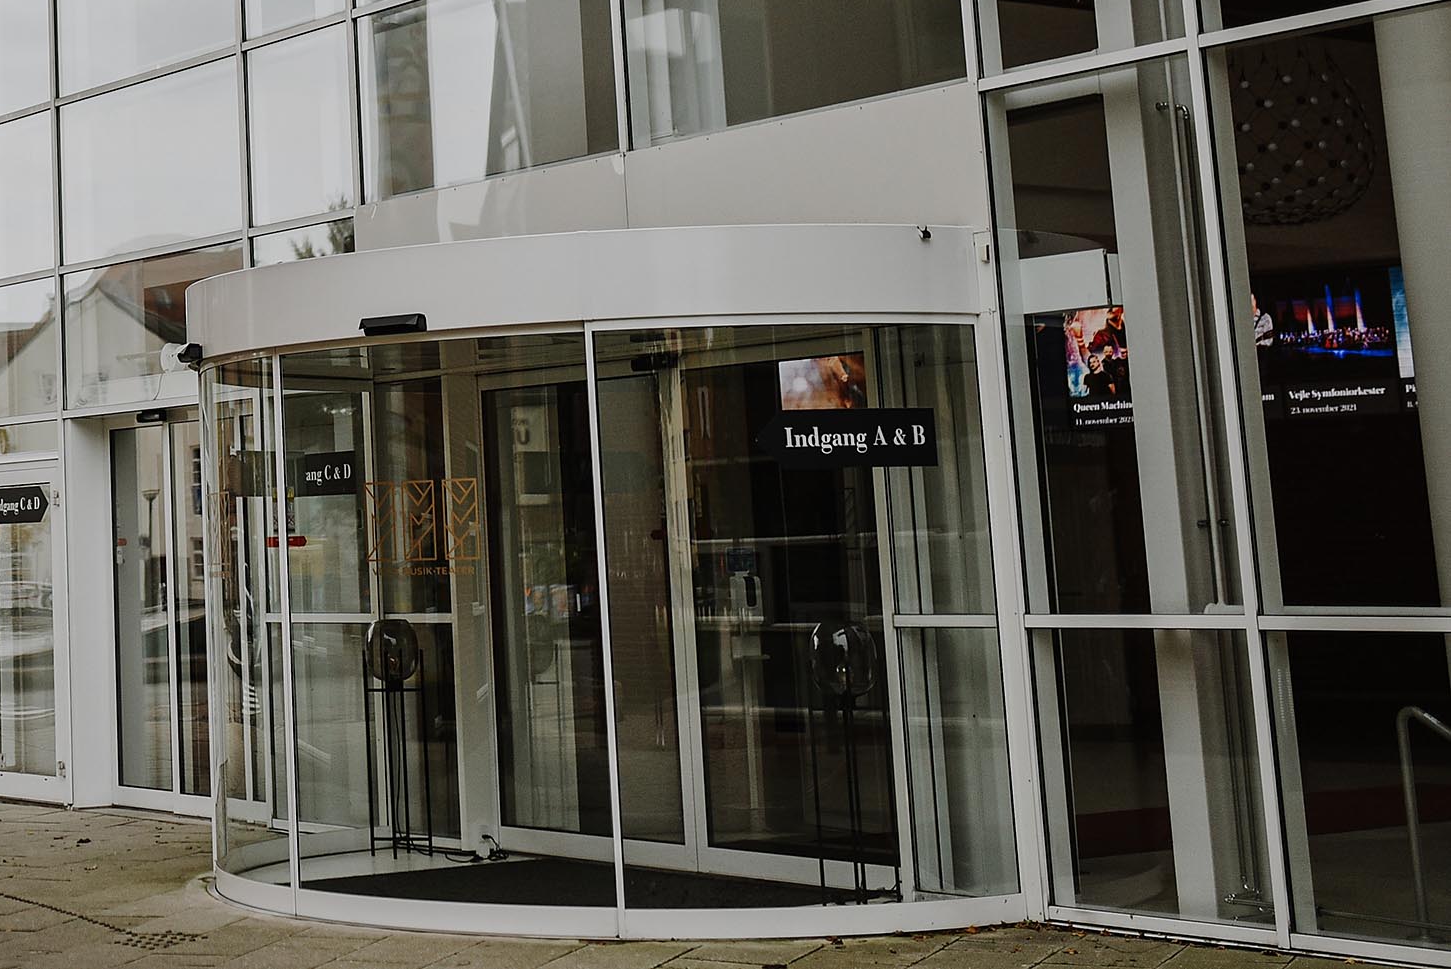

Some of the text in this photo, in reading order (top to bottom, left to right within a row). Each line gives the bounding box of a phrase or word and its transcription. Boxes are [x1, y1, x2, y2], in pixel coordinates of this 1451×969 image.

[1288, 386, 1386, 401] Vejle Symfoniorkester
[1073, 403, 1100, 413] Queen
[1302, 404, 1339, 414] november
[1340, 404, 1357, 412] 2021
[1084, 416, 1118, 426] november
[784, 424, 926, 455] Indgang A & B
[324, 464, 332, 481] C
[333, 466, 341, 480] &
[343, 463, 351, 479] D
[19, 497, 26, 511] C
[26, 498, 33, 510] &
[33, 496, 41, 510] D
